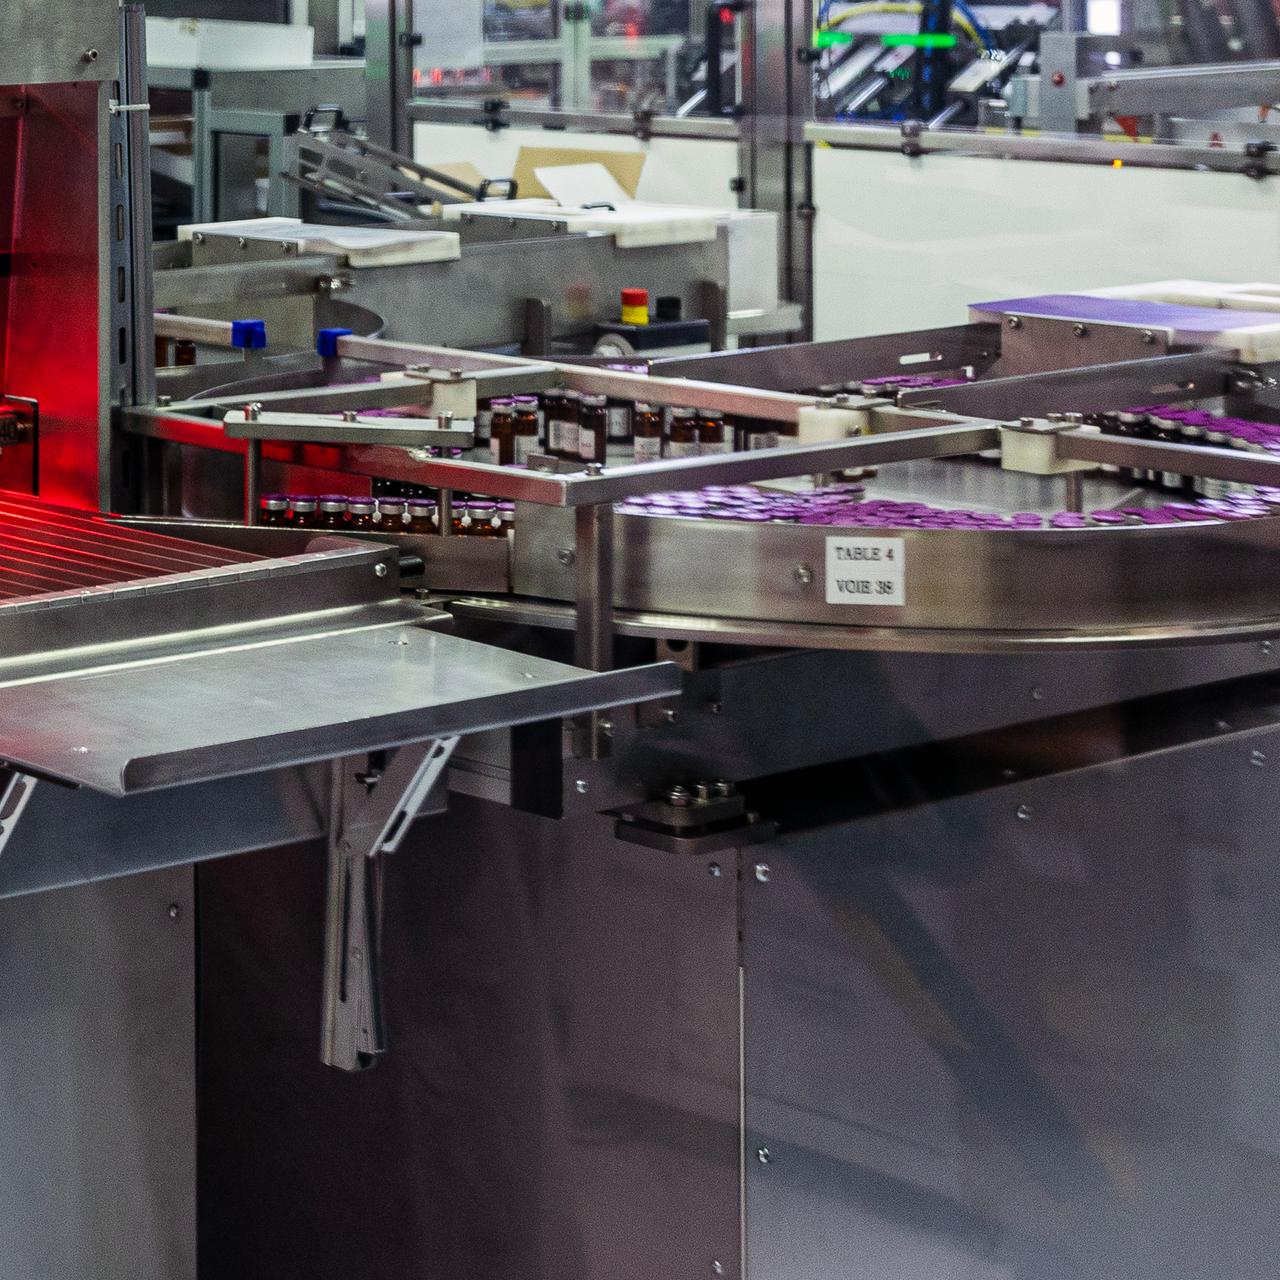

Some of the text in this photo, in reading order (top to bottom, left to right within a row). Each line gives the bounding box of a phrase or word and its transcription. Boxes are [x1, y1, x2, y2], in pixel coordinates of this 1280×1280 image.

[836, 546, 894, 561] TABLE 4
[836, 580, 872, 594] VOIE
